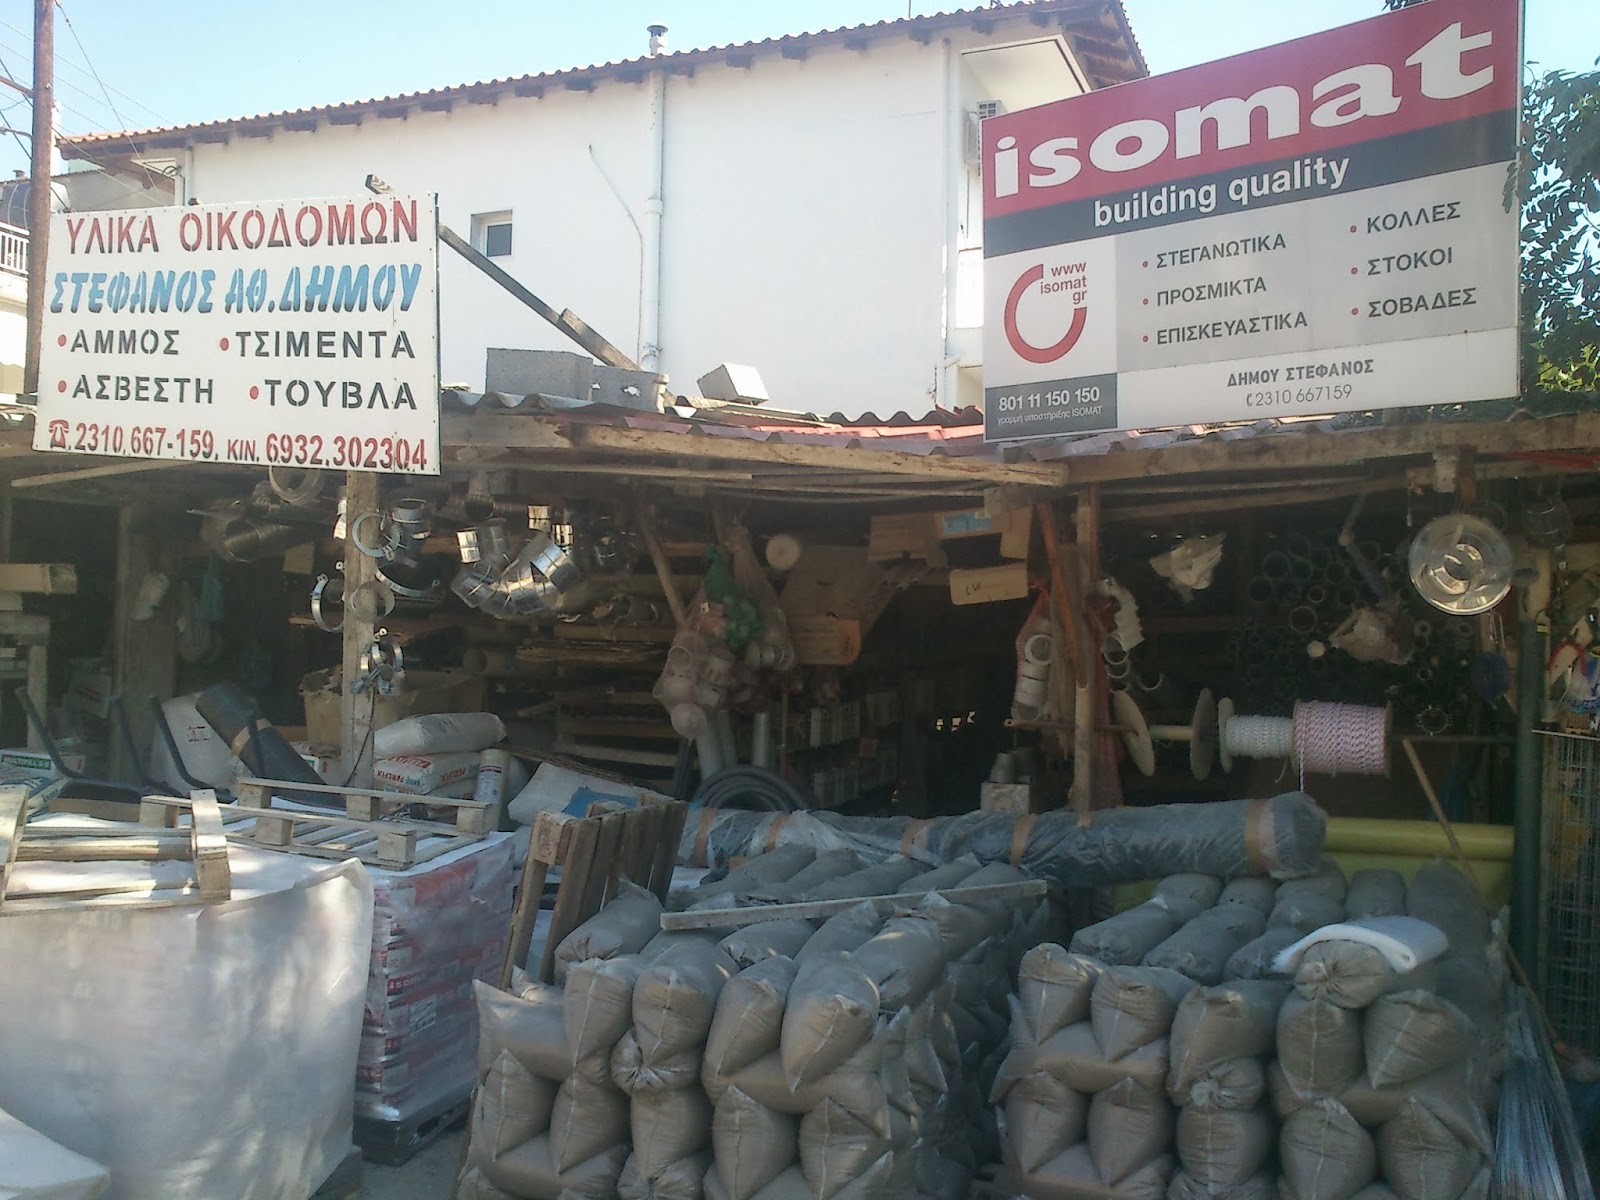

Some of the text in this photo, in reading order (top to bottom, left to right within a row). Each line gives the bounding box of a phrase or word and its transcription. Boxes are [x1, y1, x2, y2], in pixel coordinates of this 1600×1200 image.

[994, 20, 1494, 198] isomat
[1093, 155, 1350, 228] building quality
[66, 199, 418, 255] ΥΛΙΚΑ ΟΙΚΟΔΟΜΩΝ
[1366, 201, 1461, 233] ΚΟΛΛΕΣ
[1156, 234, 1287, 268] ΣΤΕΓΑΝΩΤΙΚΑ
[1367, 247, 1453, 276] ΣΤΟΚΟΙ
[1051, 262, 1086, 276] www
[50, 269, 215, 314] ΣΤΕΦΑΝΟΣ
[1041, 275, 1086, 294] isomat
[1073, 291, 1087, 304] gr
[1157, 277, 1267, 306] ΠΡΟΣΜΙΚΤΑ
[1368, 288, 1478, 318] ΣΟΒΑΔΕΣ
[70, 329, 180, 355] ΑΜΜΟΣ
[1156, 311, 1308, 345] ΕΠΙΣΚΕΥΑΣΤΙΚΑ
[235, 330, 415, 358] ΤΣΙΜΕΝΤΑ
[1227, 359, 1374, 387] ΔΗΜΟΥ ΣΤΕΦΑΝΟΣ
[72, 374, 214, 404] ΑΣΒΕΣΤΗ
[265, 379, 417, 410] ΤΟΥΒΛΑ
[999, 387, 1100, 411] 801 11 150 150
[1256, 384, 1352, 406] 2310 667159
[1072, 406, 1102, 417] ISOMAT
